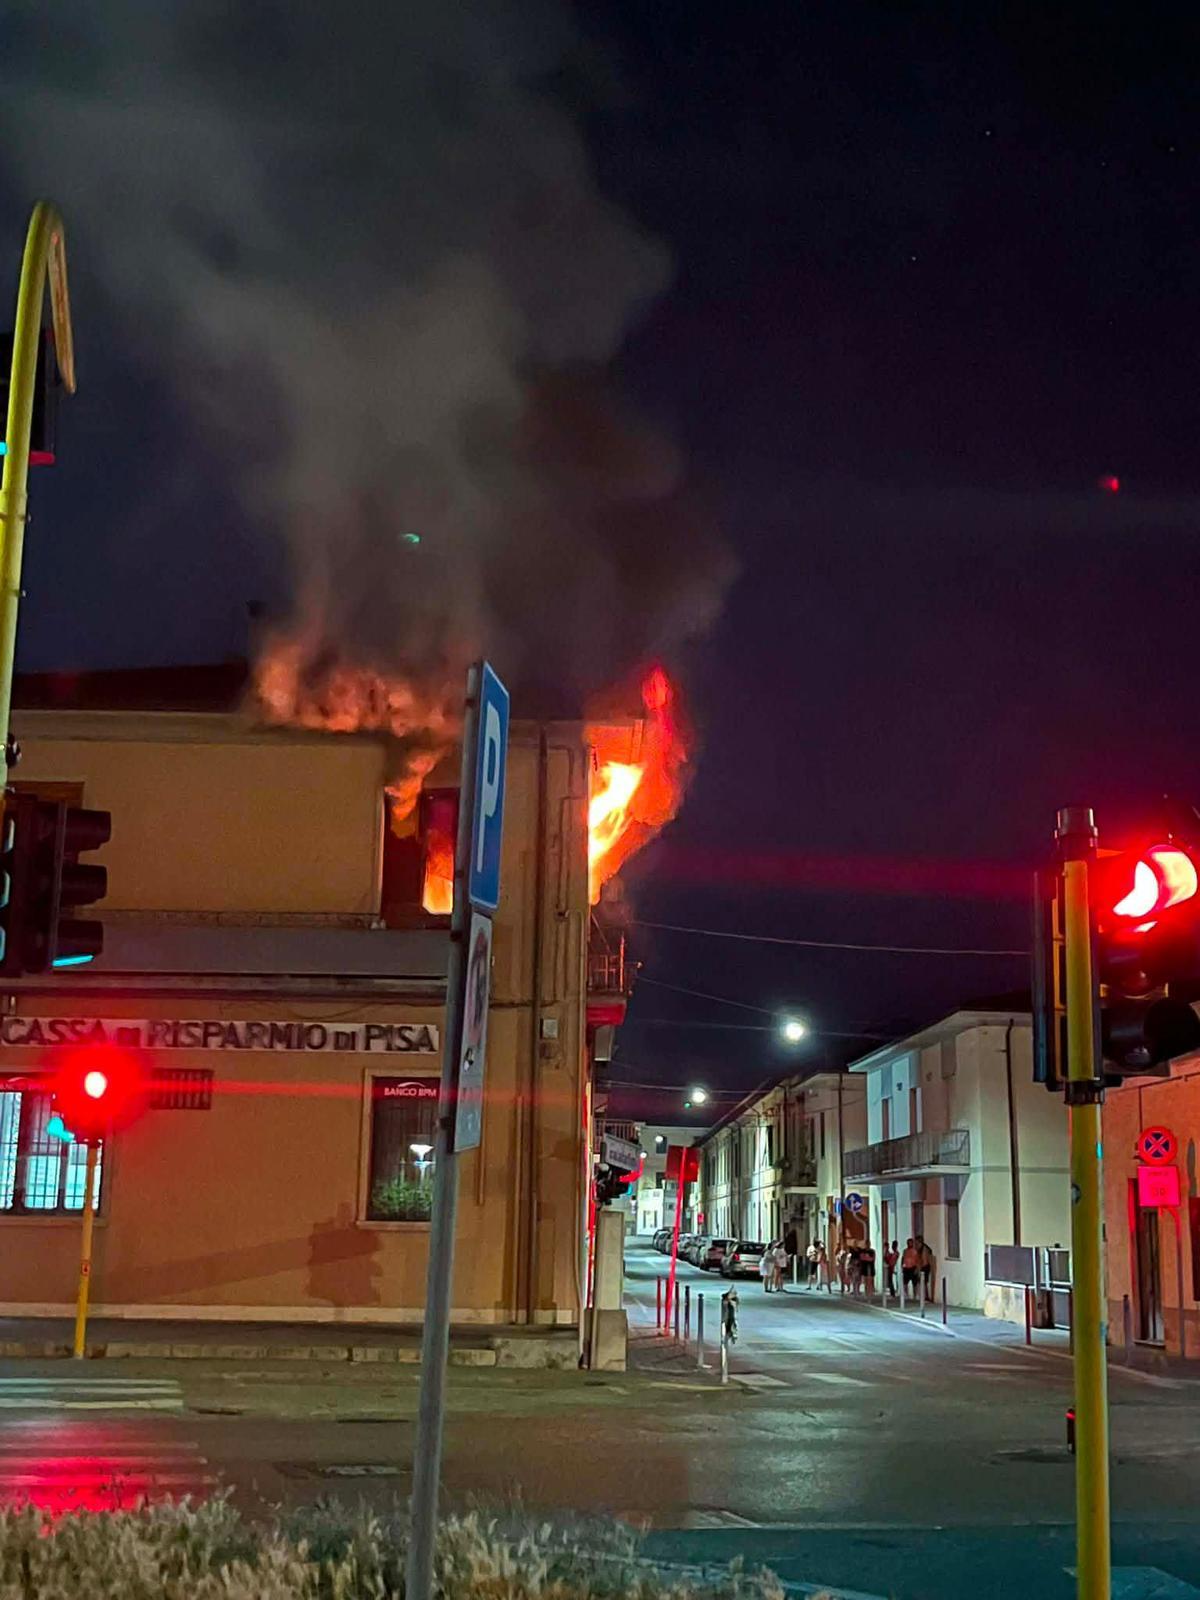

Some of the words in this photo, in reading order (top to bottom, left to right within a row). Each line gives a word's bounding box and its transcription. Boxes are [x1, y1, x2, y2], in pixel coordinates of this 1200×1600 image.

[477, 700, 501, 873] P
[1, 1018, 106, 1045] CASSA
[147, 1021, 327, 1050] RISPARMIO
[334, 1031, 356, 1051] DI
[364, 1024, 438, 1052] PISA
[384, 1087, 417, 1097] BANCO
